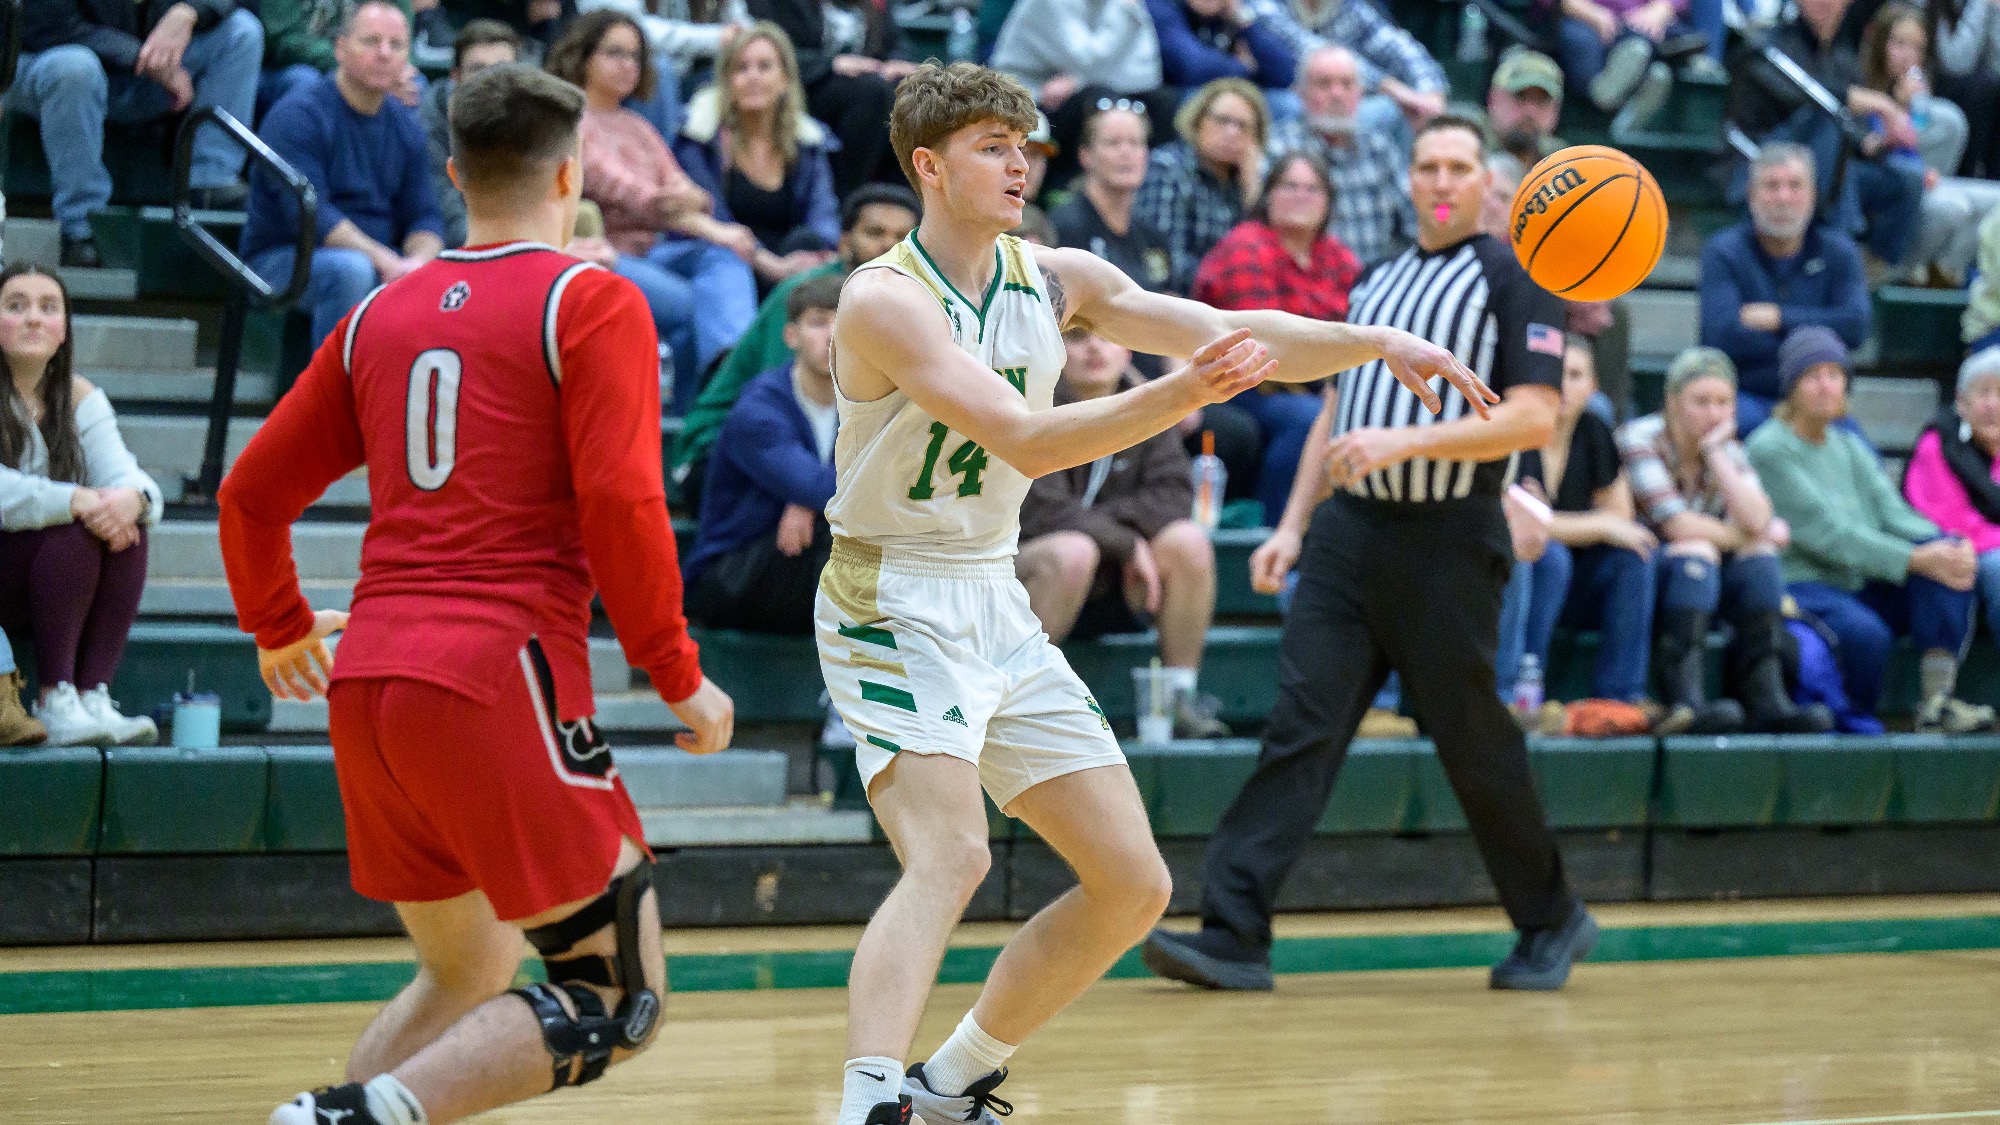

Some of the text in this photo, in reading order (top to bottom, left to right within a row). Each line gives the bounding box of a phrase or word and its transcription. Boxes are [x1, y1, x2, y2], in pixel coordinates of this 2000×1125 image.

[1514, 167, 1587, 244] Wilson
[406, 347, 463, 491] 0
[992, 366, 1028, 399] N
[908, 421, 988, 500] 14
[942, 714, 969, 728] adidas
